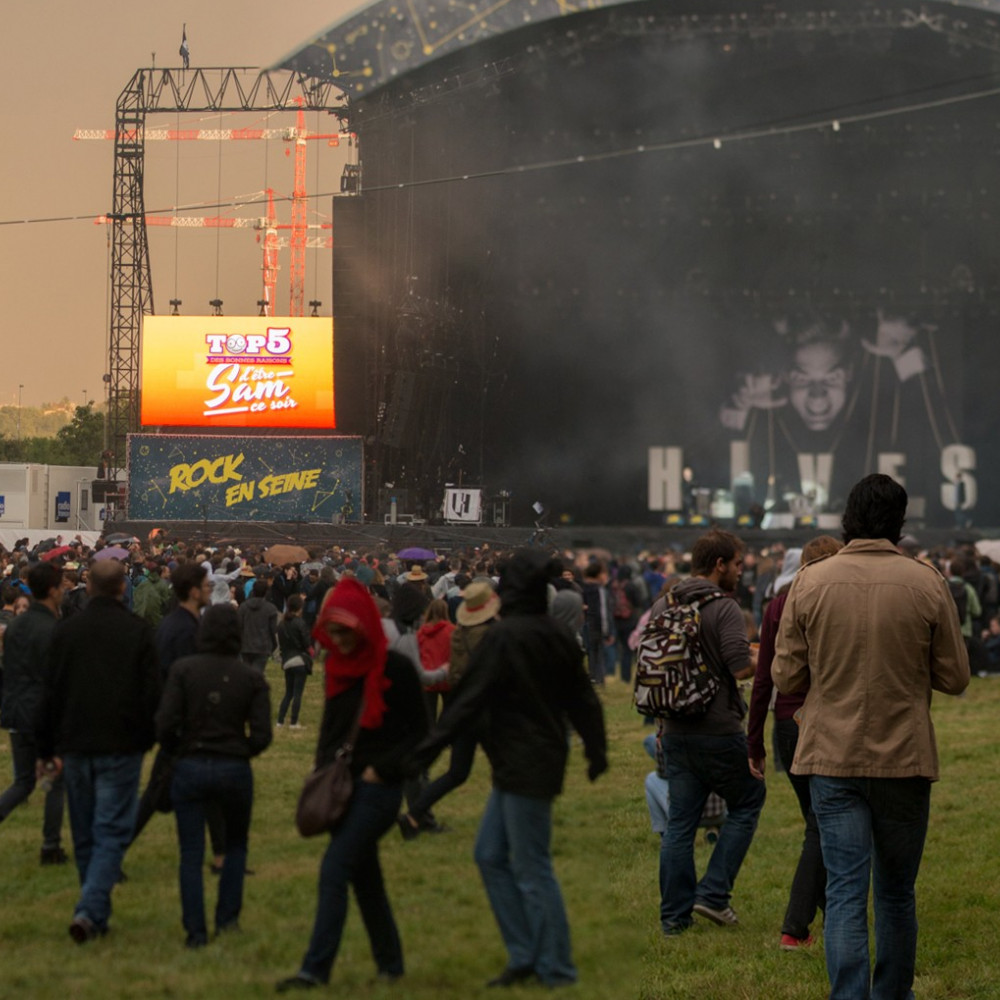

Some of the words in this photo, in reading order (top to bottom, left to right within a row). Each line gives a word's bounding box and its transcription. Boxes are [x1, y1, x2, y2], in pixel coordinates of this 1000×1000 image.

[204, 363, 290, 408] Sam
[250, 401, 267, 412] ce
[270, 396, 298, 410] soir
[168, 452, 245, 494] ROCK
[225, 480, 256, 507] EN
[258, 468, 322, 499] SEINE
